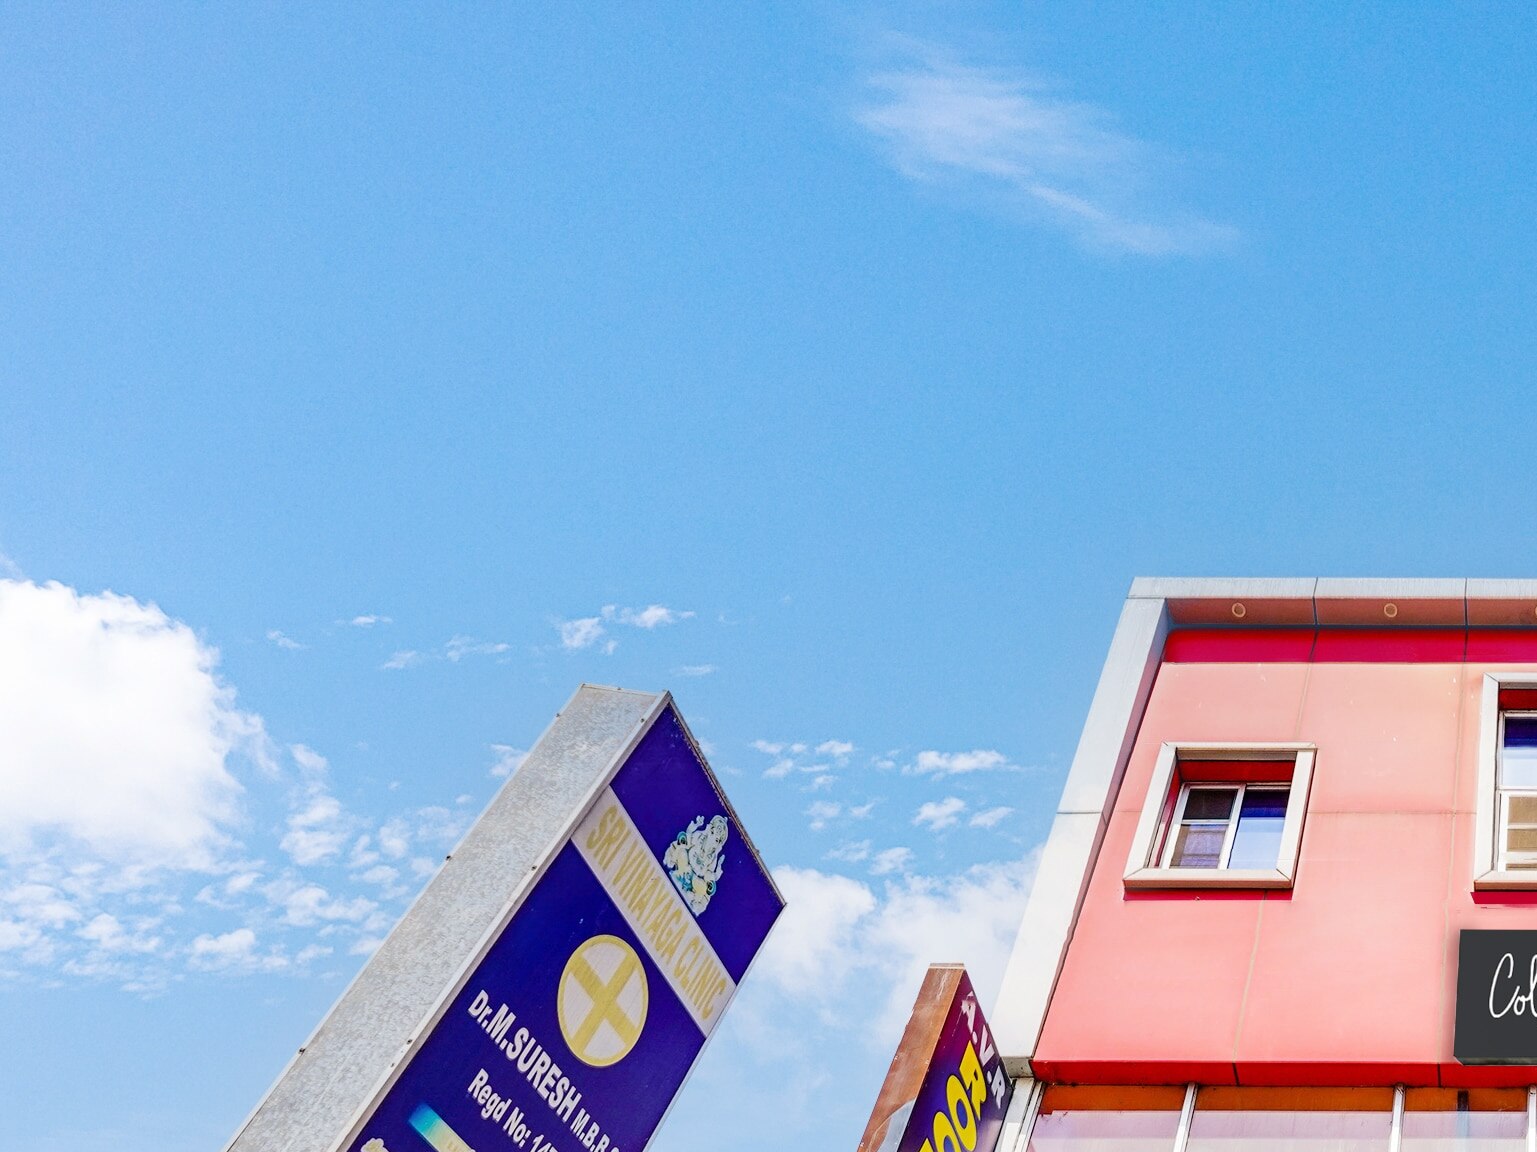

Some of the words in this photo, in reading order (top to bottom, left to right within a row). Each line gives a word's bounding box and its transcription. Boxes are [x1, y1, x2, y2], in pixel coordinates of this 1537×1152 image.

[586, 804, 631, 872] SRI
[612, 841, 689, 966] VINAYAGA
[673, 935, 728, 1020] CLINIC
[468, 989, 582, 1123] Dr.M.SURESH
[468, 1068, 512, 1123] Regd
[503, 1107, 531, 1150] No:
